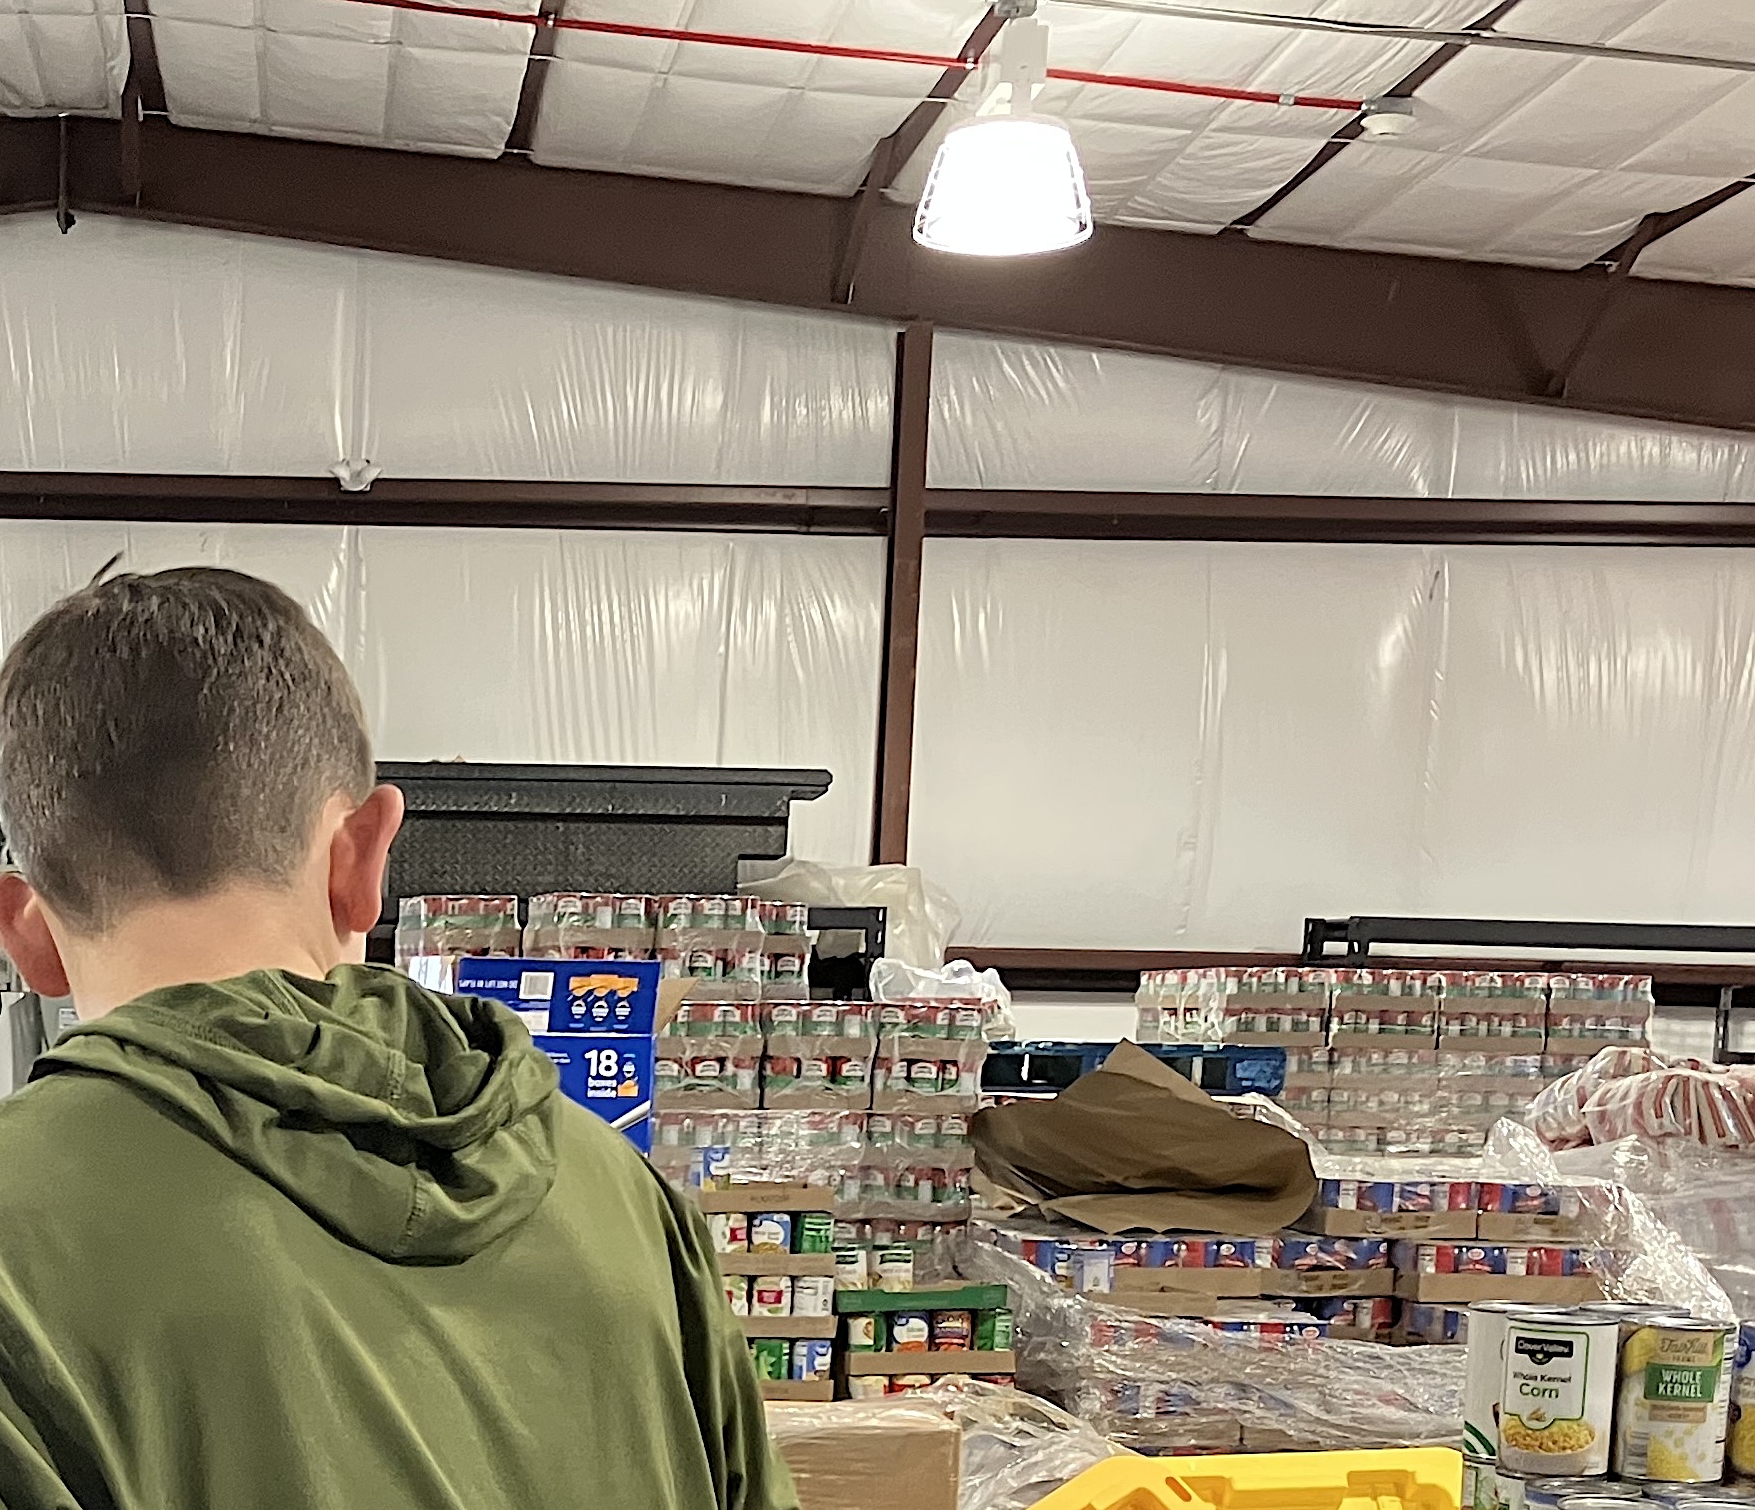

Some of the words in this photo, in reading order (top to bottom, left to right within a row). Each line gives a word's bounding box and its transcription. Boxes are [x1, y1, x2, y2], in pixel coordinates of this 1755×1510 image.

[584, 1049, 619, 1077] 18
[587, 1077, 617, 1087] boxes
[587, 1088, 617, 1099] inside
[1512, 1371, 1539, 1382] Whole
[1539, 1373, 1573, 1384] Kernel
[1661, 1369, 1703, 1384] WHOLE
[1519, 1382, 1560, 1399] Corn
[1657, 1383, 1703, 1398] KERNEL
